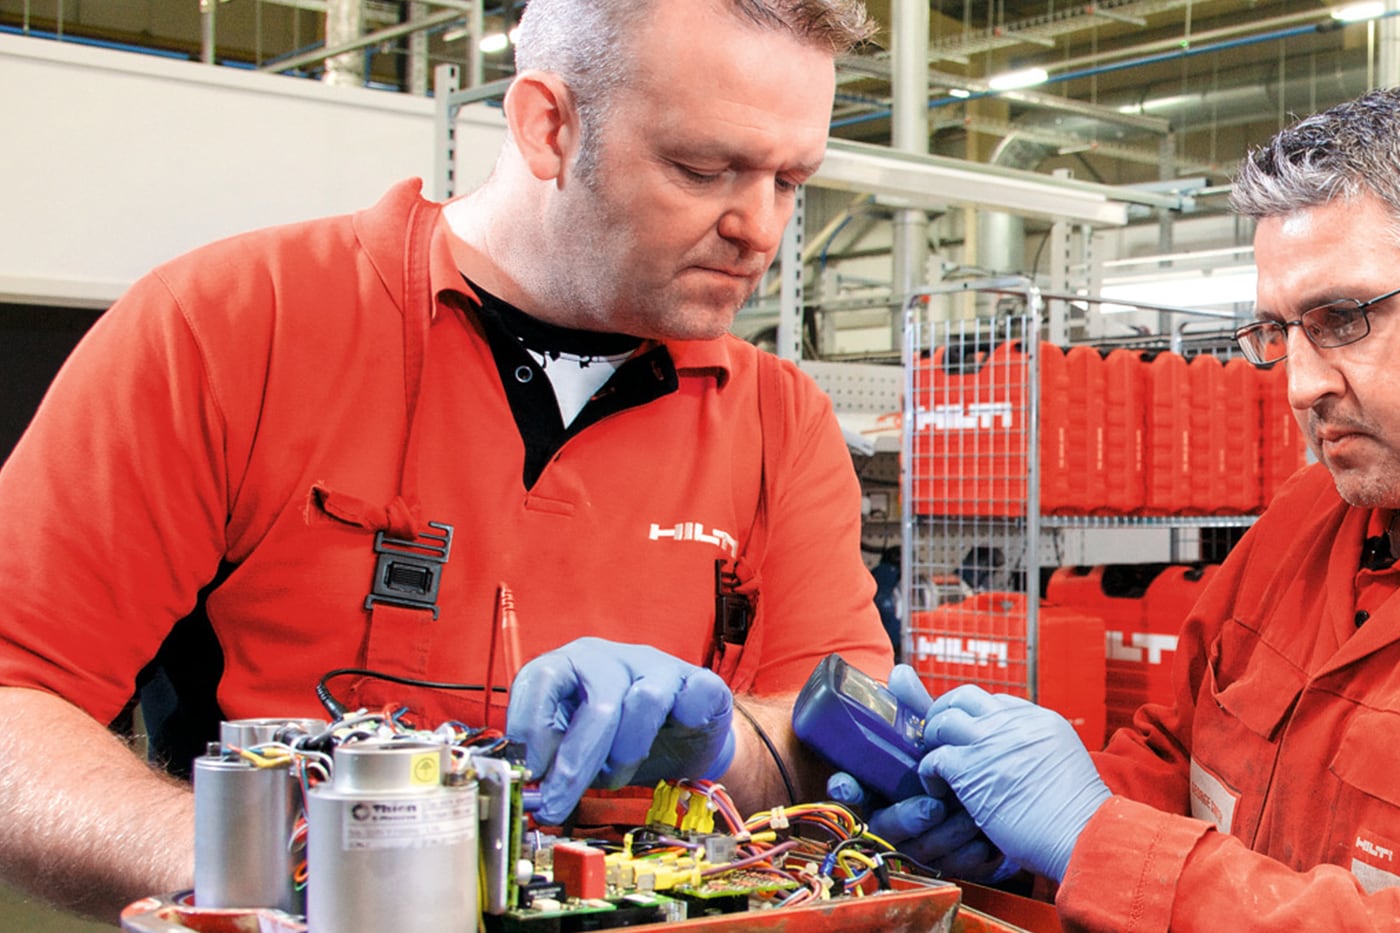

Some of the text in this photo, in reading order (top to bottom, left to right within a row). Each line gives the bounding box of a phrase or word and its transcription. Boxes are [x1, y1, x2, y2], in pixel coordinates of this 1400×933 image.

[916, 402, 1012, 430] HILTI
[648, 522, 738, 559] HILTI
[917, 636, 1008, 668] HILTI
[1355, 836, 1393, 862] HILTI
